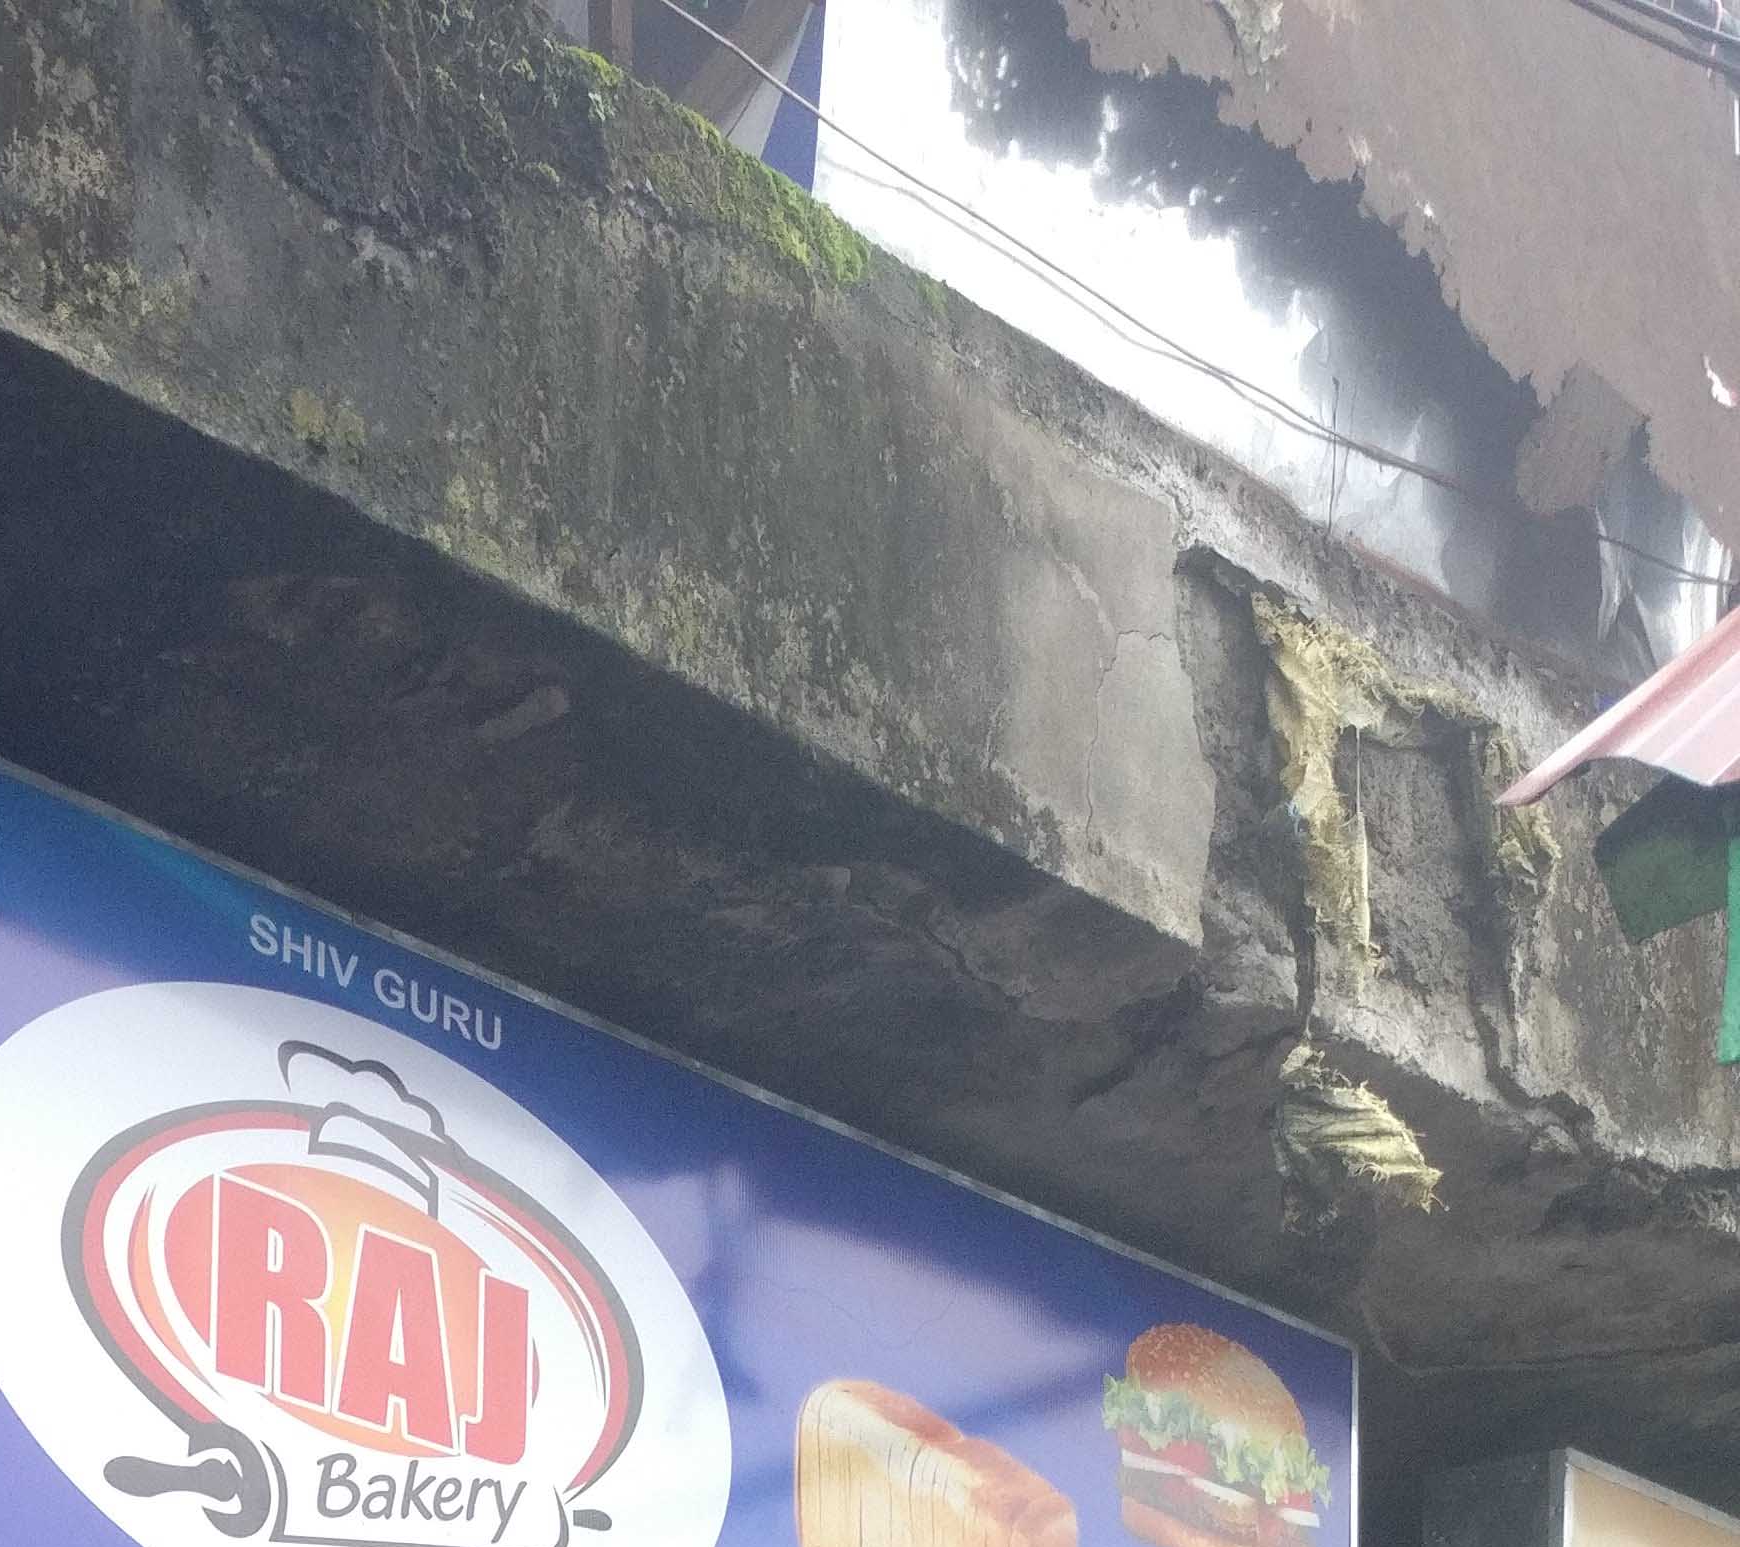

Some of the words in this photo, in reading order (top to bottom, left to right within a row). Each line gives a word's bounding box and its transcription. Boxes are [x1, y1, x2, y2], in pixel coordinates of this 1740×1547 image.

[248, 912, 359, 990] SHIV
[372, 966, 503, 1052] GURU
[315, 1453, 528, 1545] Bakery
